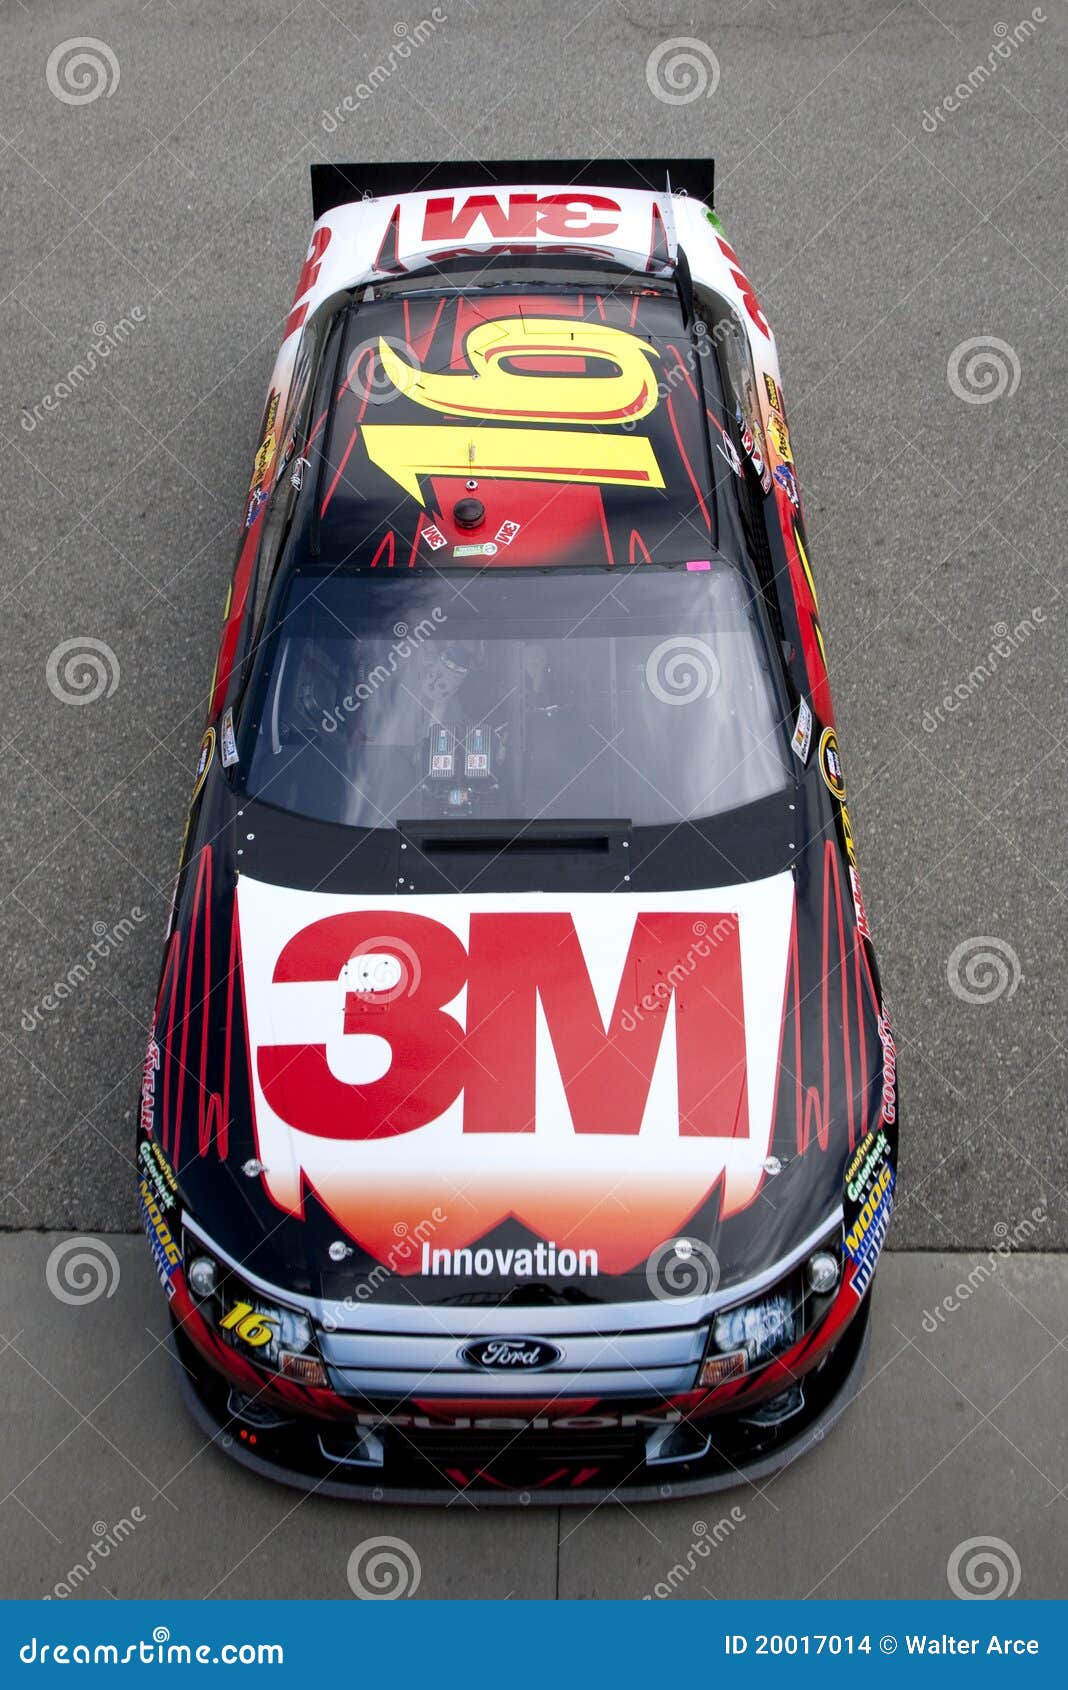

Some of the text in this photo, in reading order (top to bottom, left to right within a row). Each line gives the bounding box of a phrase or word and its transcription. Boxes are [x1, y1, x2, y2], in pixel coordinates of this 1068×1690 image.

[421, 193, 622, 241] 3M
[361, 319, 666, 507] 16
[422, 526, 444, 548] 3M
[497, 522, 517, 543] 3M
[257, 910, 750, 1141] 3M
[139, 1180, 183, 1265] MOOG
[845, 1162, 891, 1258] MOOG
[421, 1241, 598, 1277] Innovation
[219, 1302, 281, 1346] 16
[482, 1342, 541, 1364] Ford
